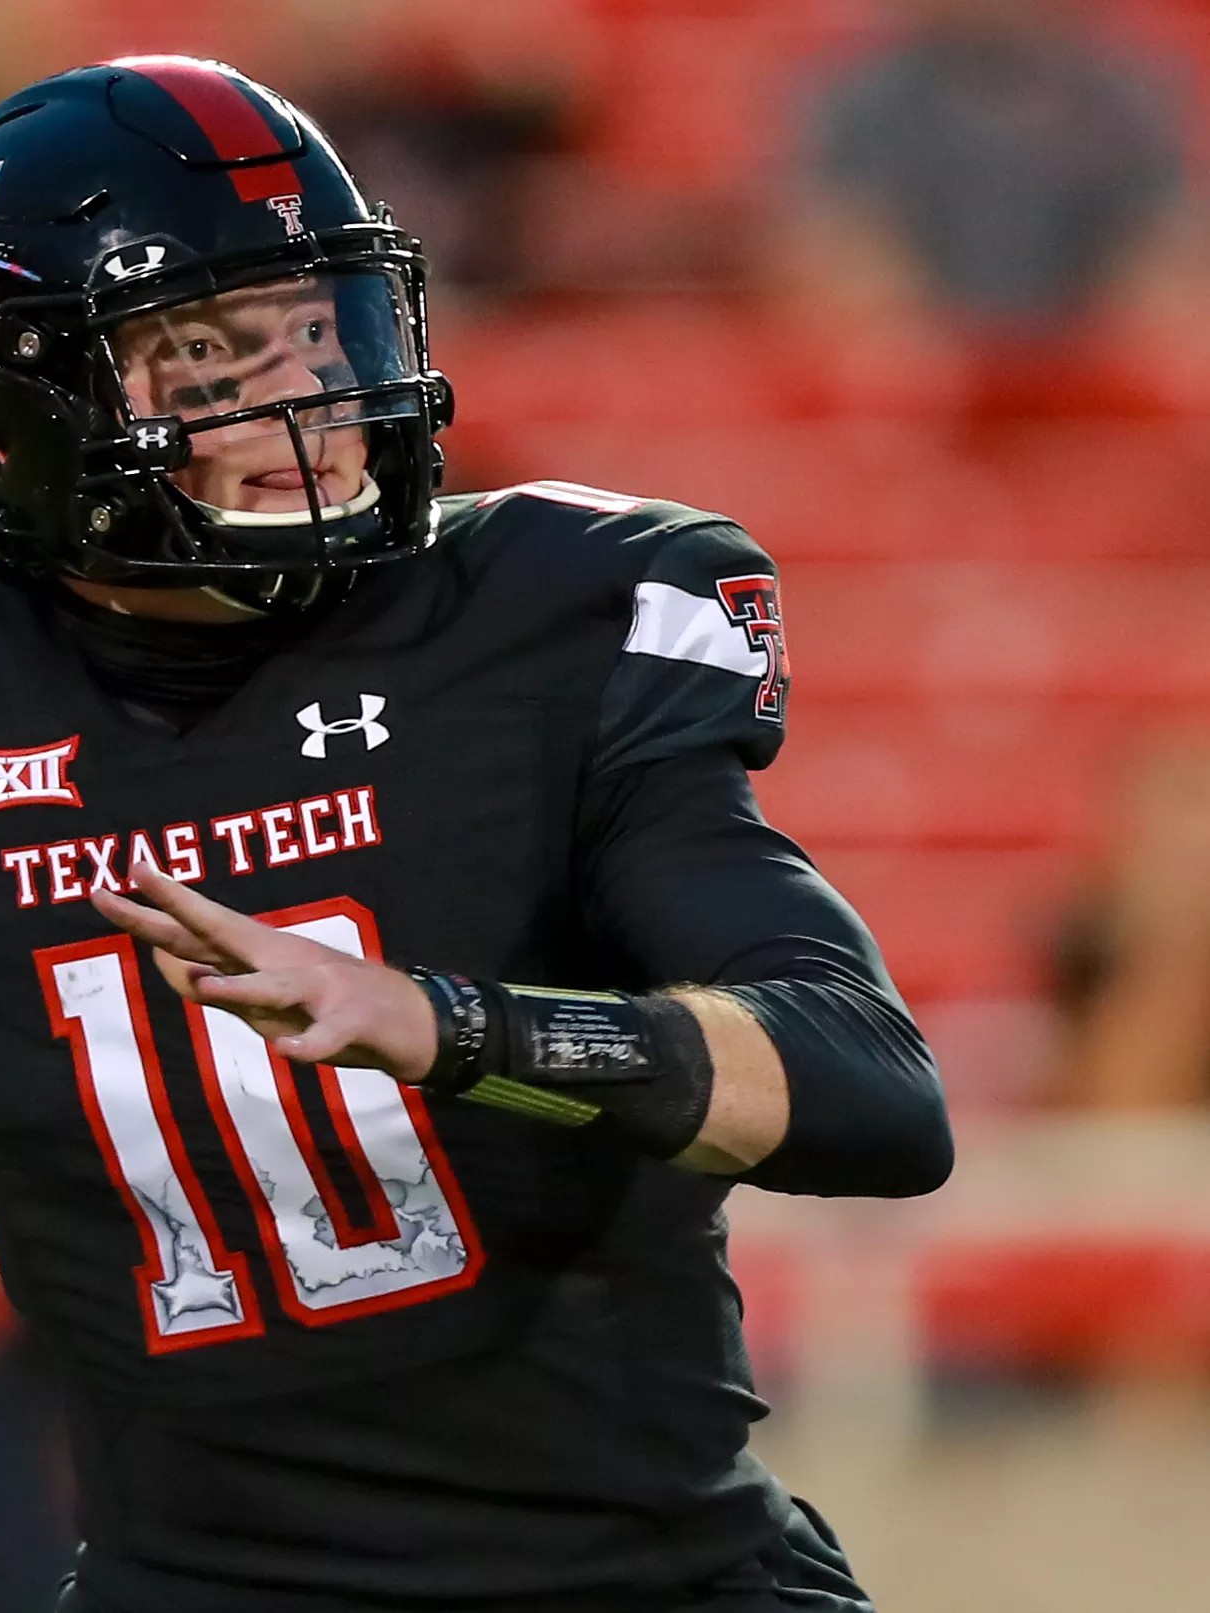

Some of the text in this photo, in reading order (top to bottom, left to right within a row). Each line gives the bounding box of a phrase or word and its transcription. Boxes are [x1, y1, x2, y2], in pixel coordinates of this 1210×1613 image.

[1, 785, 381, 907] TEXAS TECH
[32, 895, 487, 1356] 10
